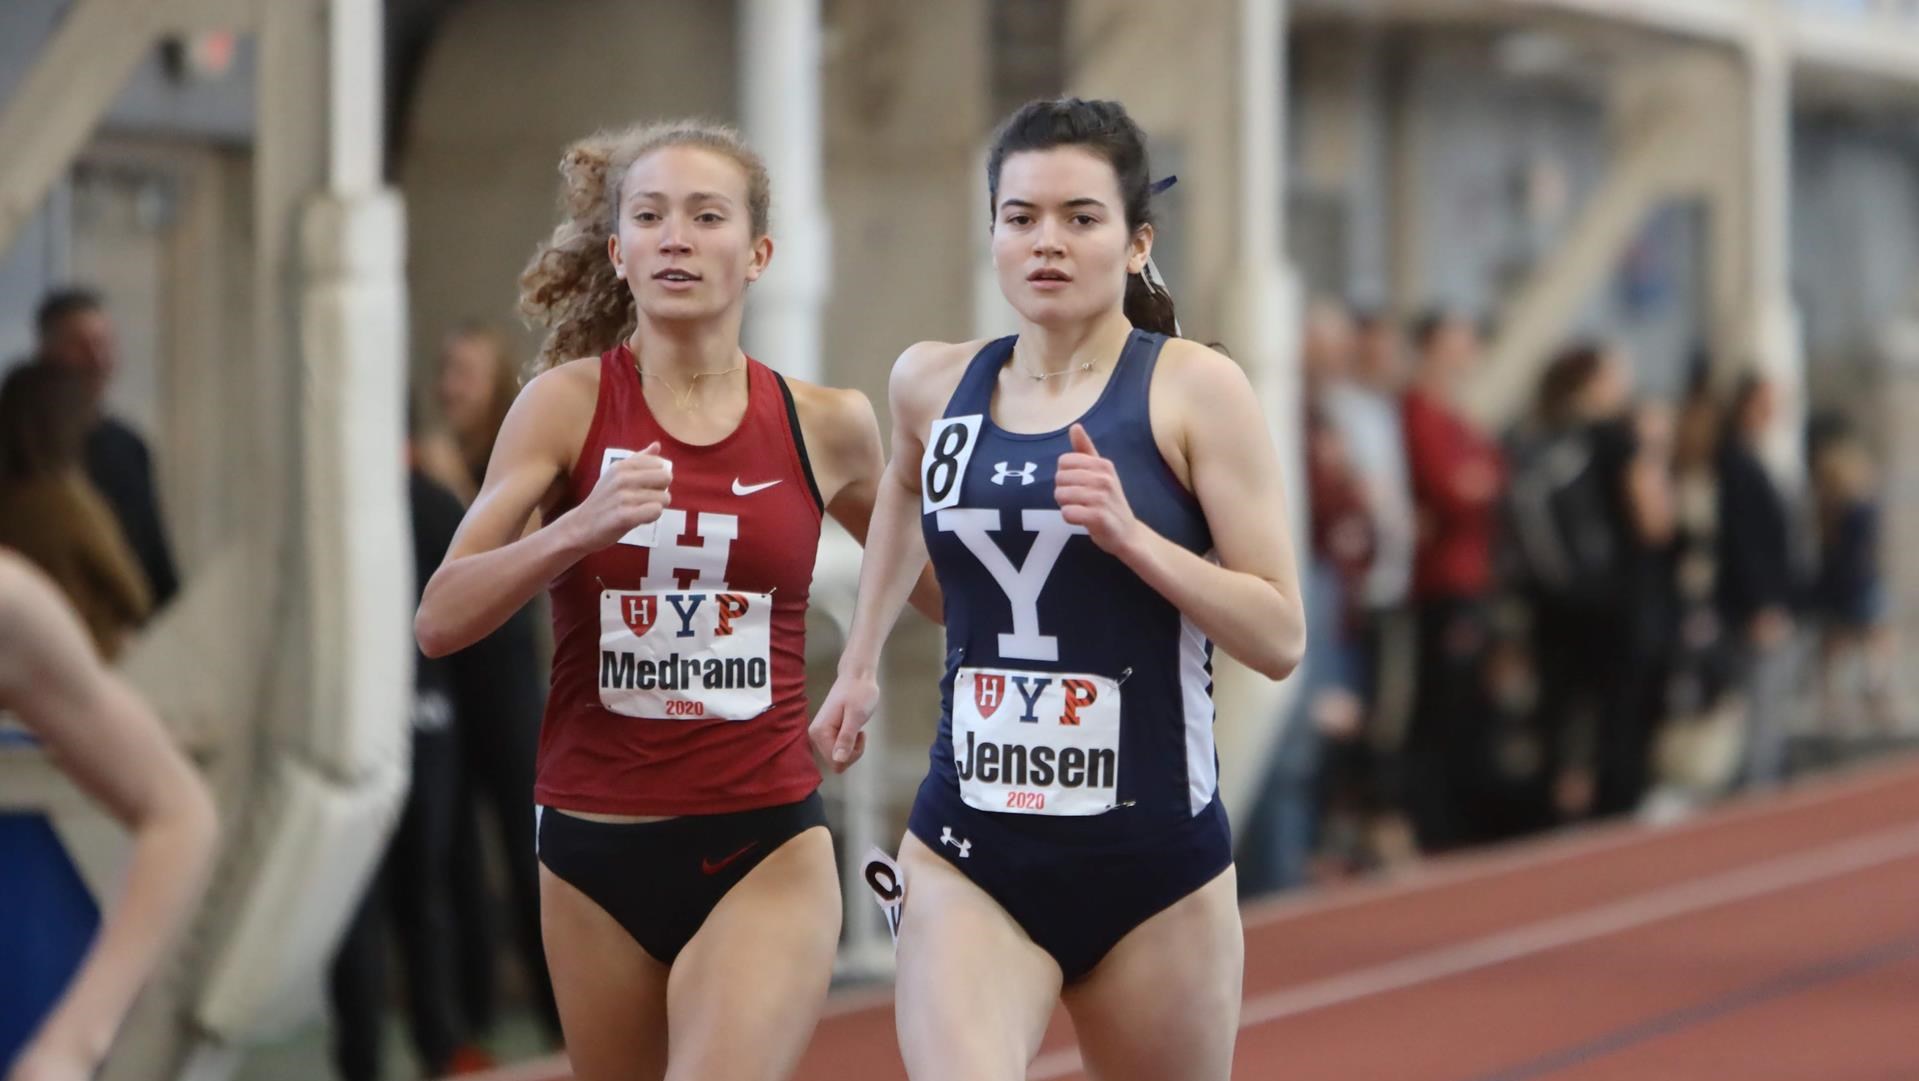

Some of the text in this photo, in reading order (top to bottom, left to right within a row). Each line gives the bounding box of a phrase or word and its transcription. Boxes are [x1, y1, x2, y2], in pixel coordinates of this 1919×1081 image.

[927, 422, 968, 503] 8
[640, 508, 738, 591] H
[937, 508, 1090, 661] Y
[601, 650, 767, 691] Medrano
[665, 700, 704, 716] 2020
[956, 731, 1115, 788] Jensen
[1006, 791, 1045, 810] 2020
